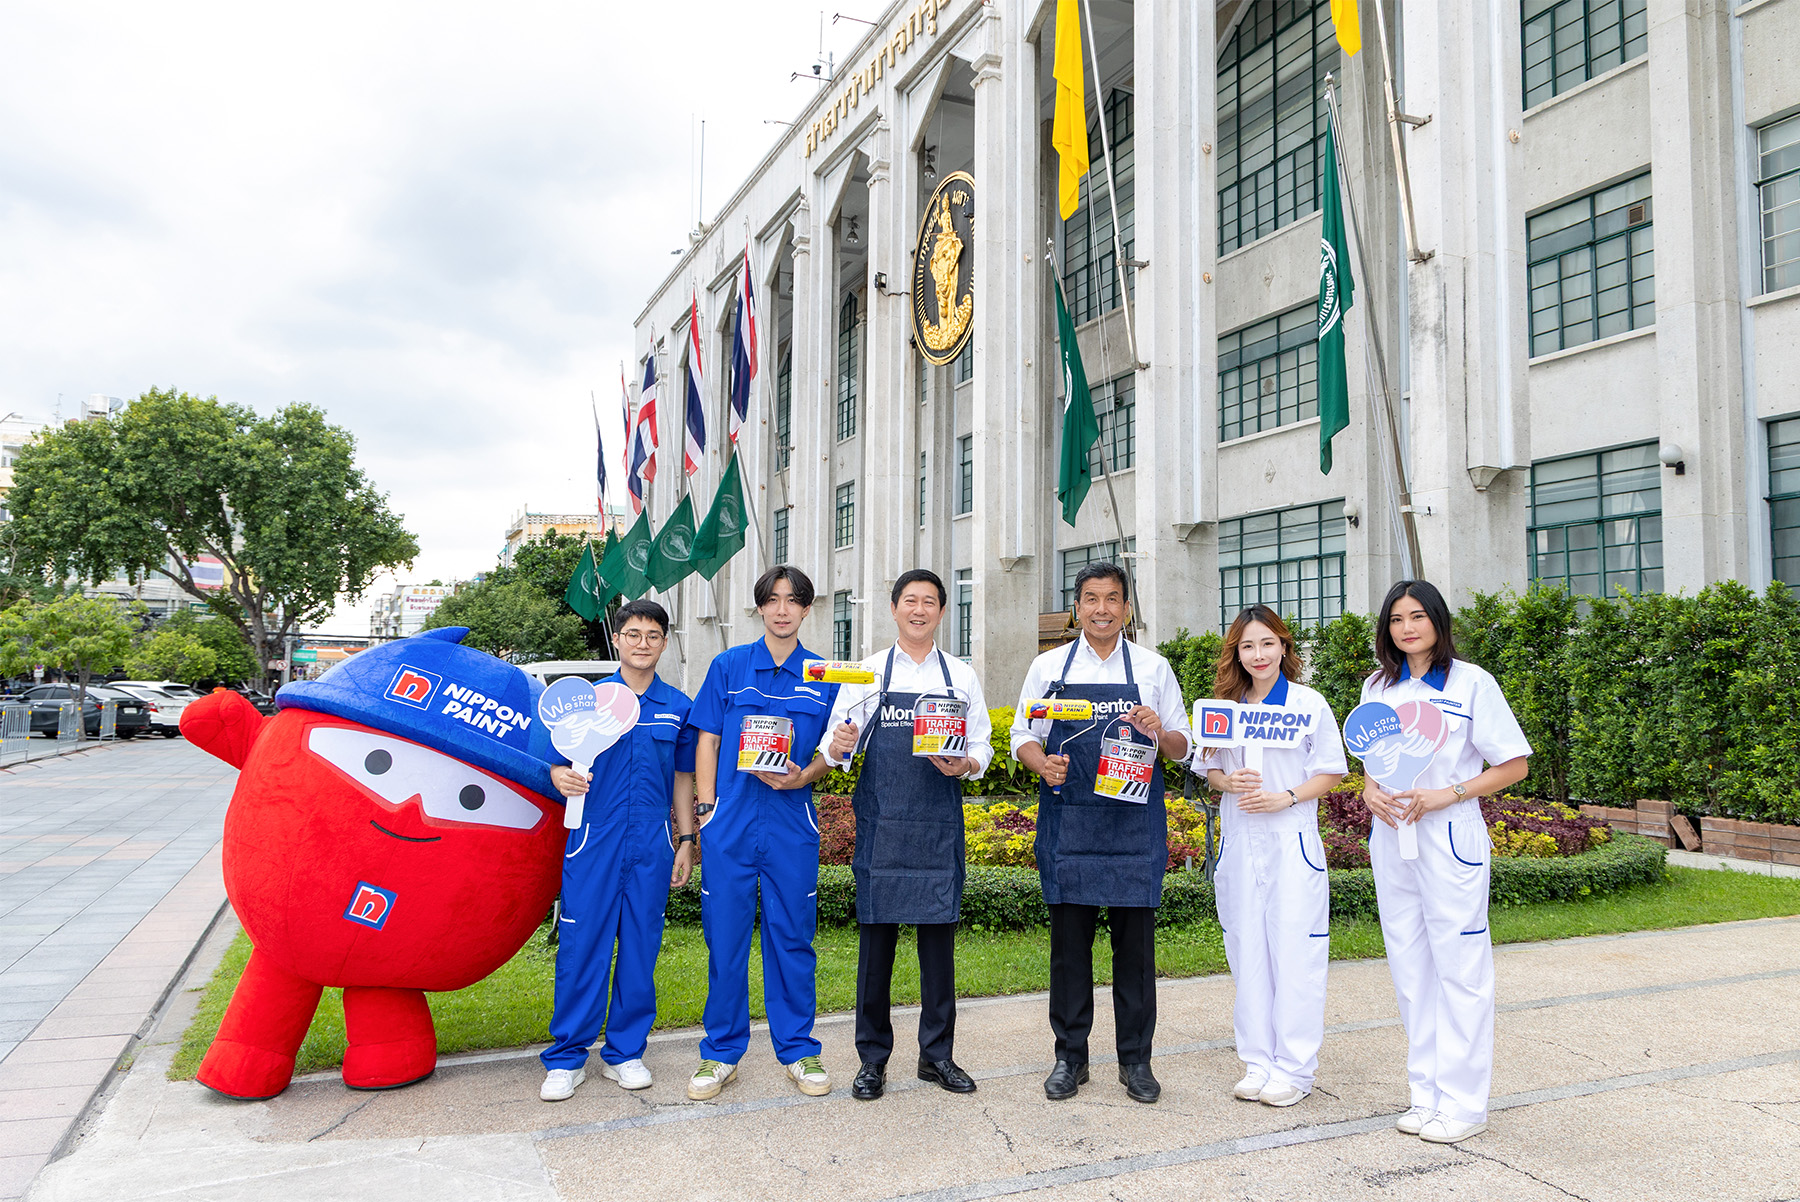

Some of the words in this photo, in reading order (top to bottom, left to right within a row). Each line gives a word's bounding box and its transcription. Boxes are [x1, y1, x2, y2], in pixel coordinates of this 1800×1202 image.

[443, 683, 532, 731] NIPPON
[541, 696, 572, 718] We
[571, 694, 593, 702] care
[573, 700, 599, 708] share
[441, 701, 513, 739] PAINT
[1238, 710, 1312, 727] NIPPON
[925, 720, 962, 729] TRAFFIC
[1377, 722, 1404, 734] share
[927, 728, 956, 736] PAINT
[1244, 726, 1299, 741] PAINT
[1346, 724, 1378, 749] We
[1374, 716, 1396, 727] care
[743, 736, 777, 745] TRAFFIC
[744, 743, 769, 751] PAINT
[1121, 746, 1147, 756] NIPPON
[1123, 752, 1143, 760] PAINT
[1107, 760, 1145, 776] TRAFFIC
[1108, 770, 1137, 781] PAINT
